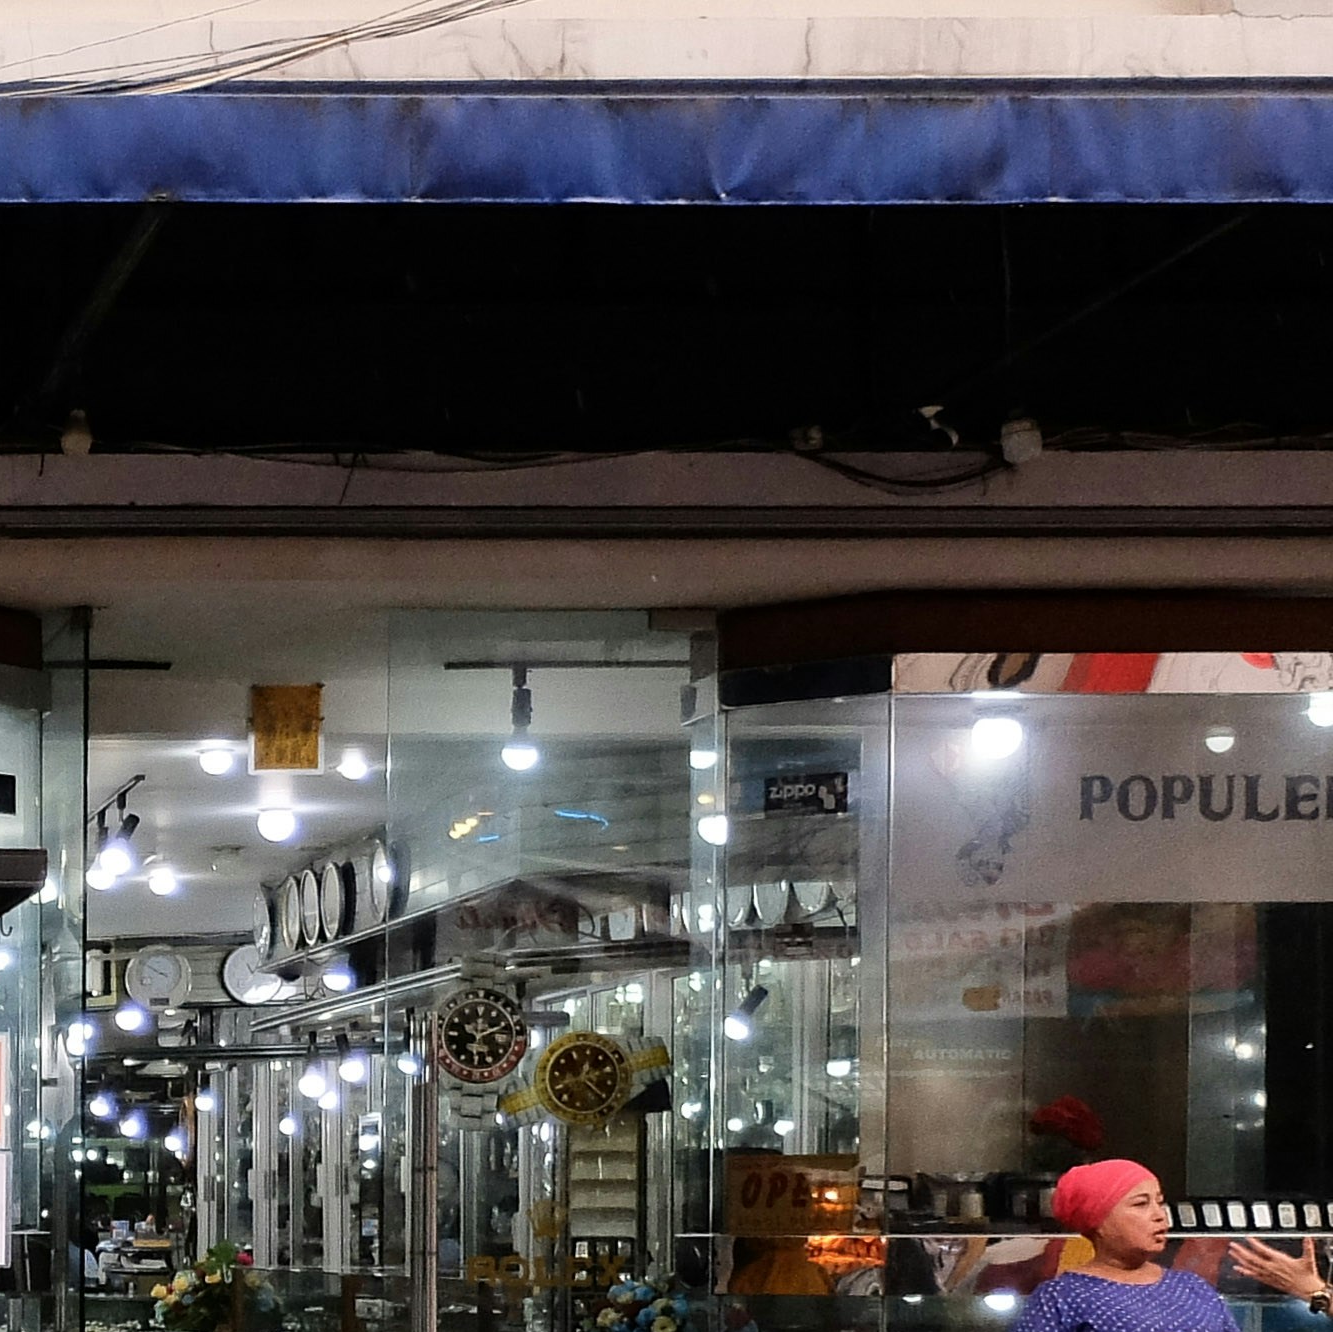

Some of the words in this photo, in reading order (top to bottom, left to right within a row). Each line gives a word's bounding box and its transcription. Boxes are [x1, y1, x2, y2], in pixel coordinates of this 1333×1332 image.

[1079, 774, 1333, 823] POPULE
[912, 1049, 1012, 1060] AUTOMATIC
[466, 1255, 629, 1288] ROLEX
